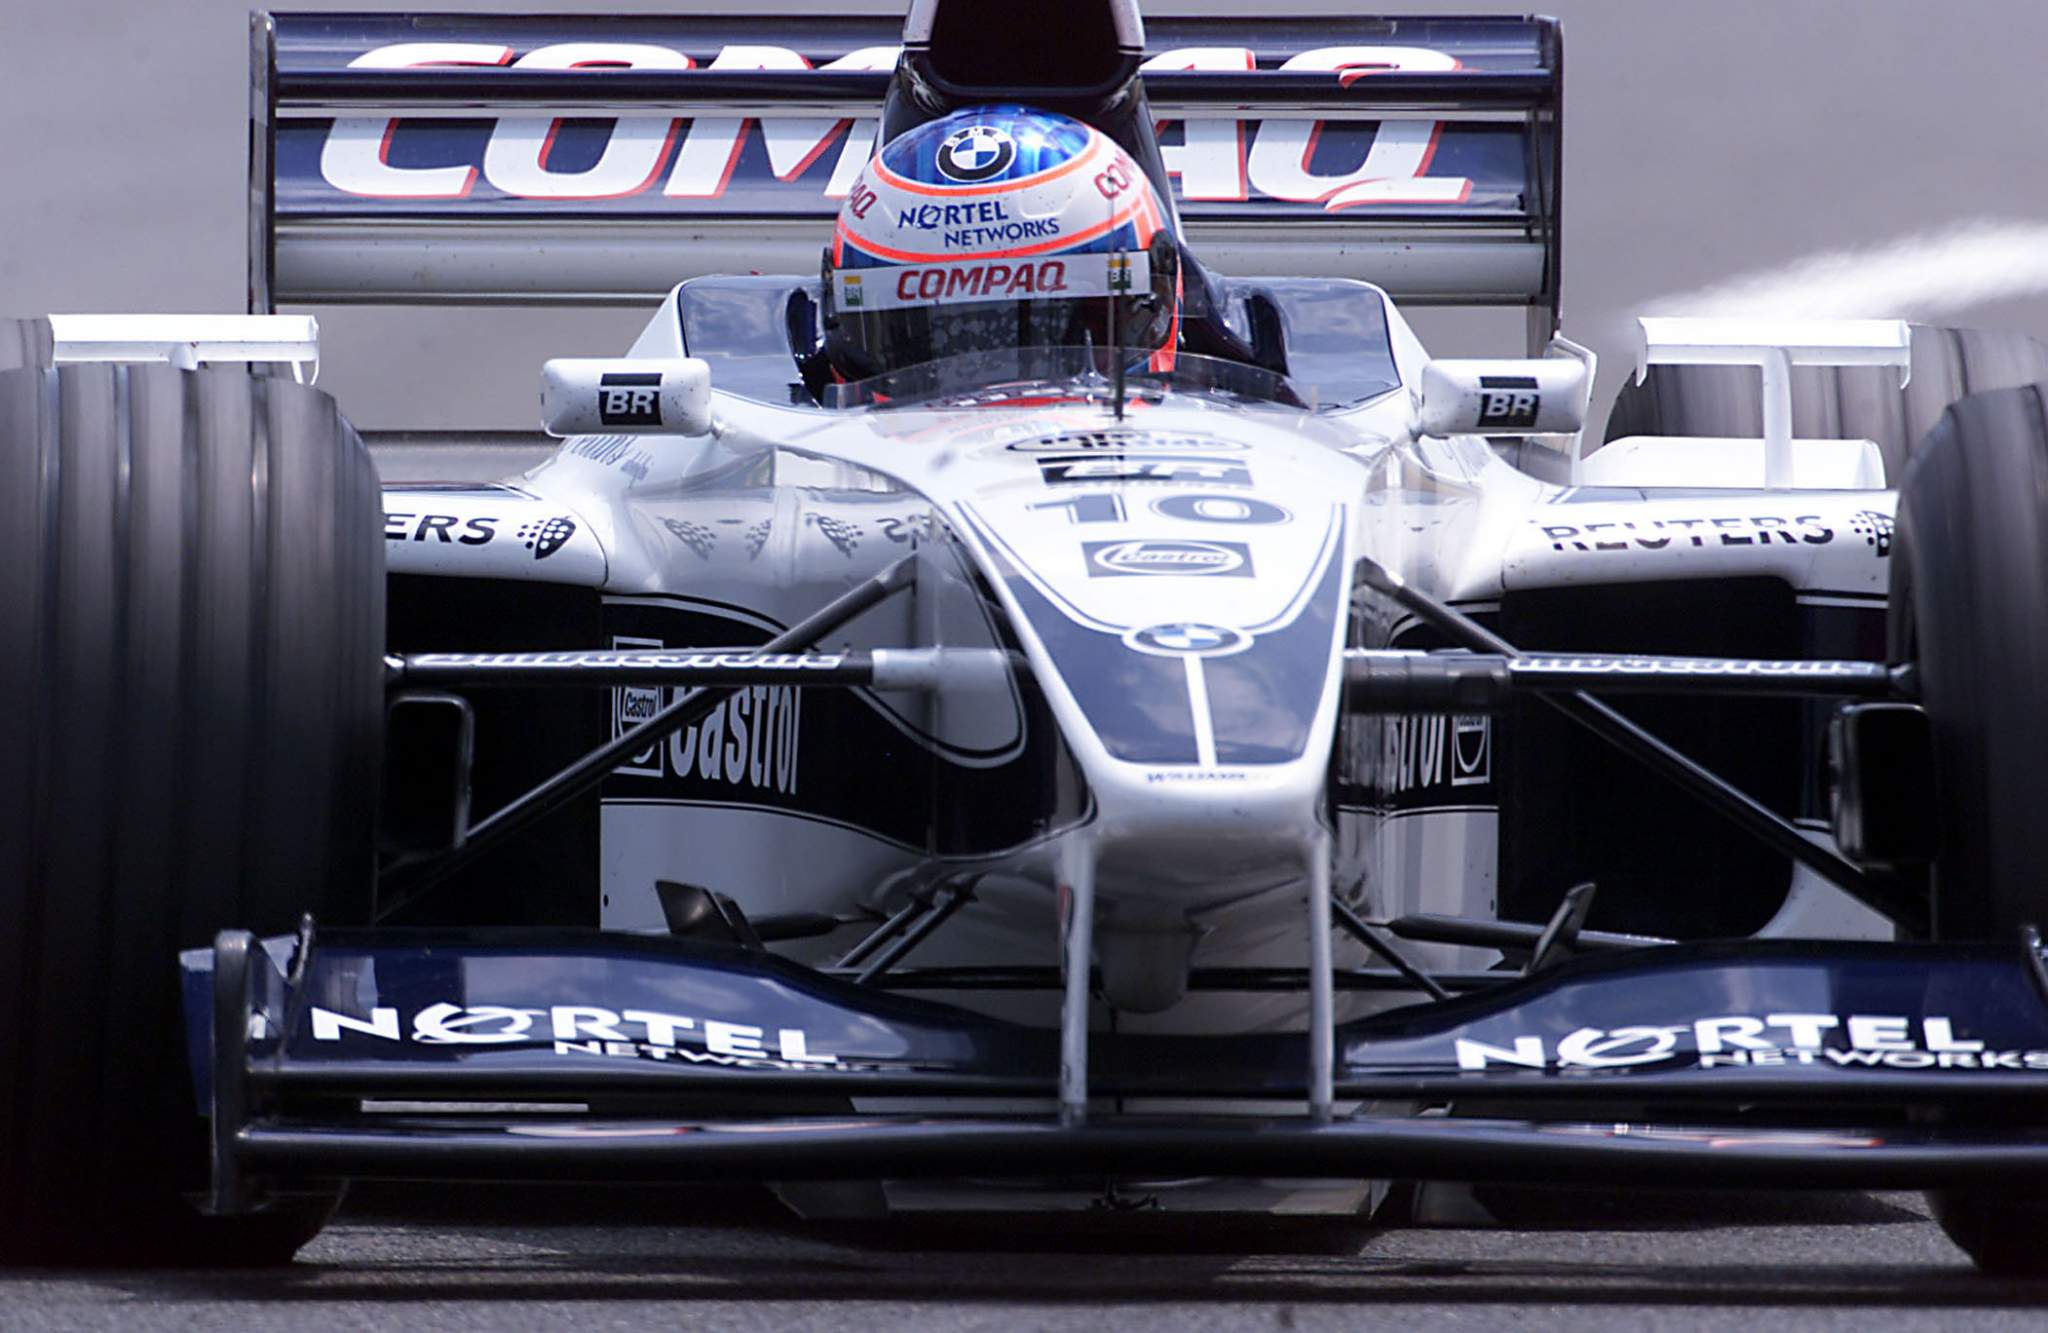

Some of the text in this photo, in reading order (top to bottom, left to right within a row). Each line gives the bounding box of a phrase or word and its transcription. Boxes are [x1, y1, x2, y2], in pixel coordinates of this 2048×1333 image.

[899, 200, 1008, 230] NORTEL
[944, 217, 1060, 249] NETWORKS
[898, 260, 1068, 301] COMPAQ
[606, 391, 654, 414] BR
[1486, 393, 1534, 416] BR
[1025, 493, 1294, 525] 10
[1542, 515, 1834, 551] REUTERS
[311, 1003, 838, 1063] NORTEL
[1456, 1014, 1984, 1071] NORTEL
[1700, 1046, 2048, 1070] NETWORKS
